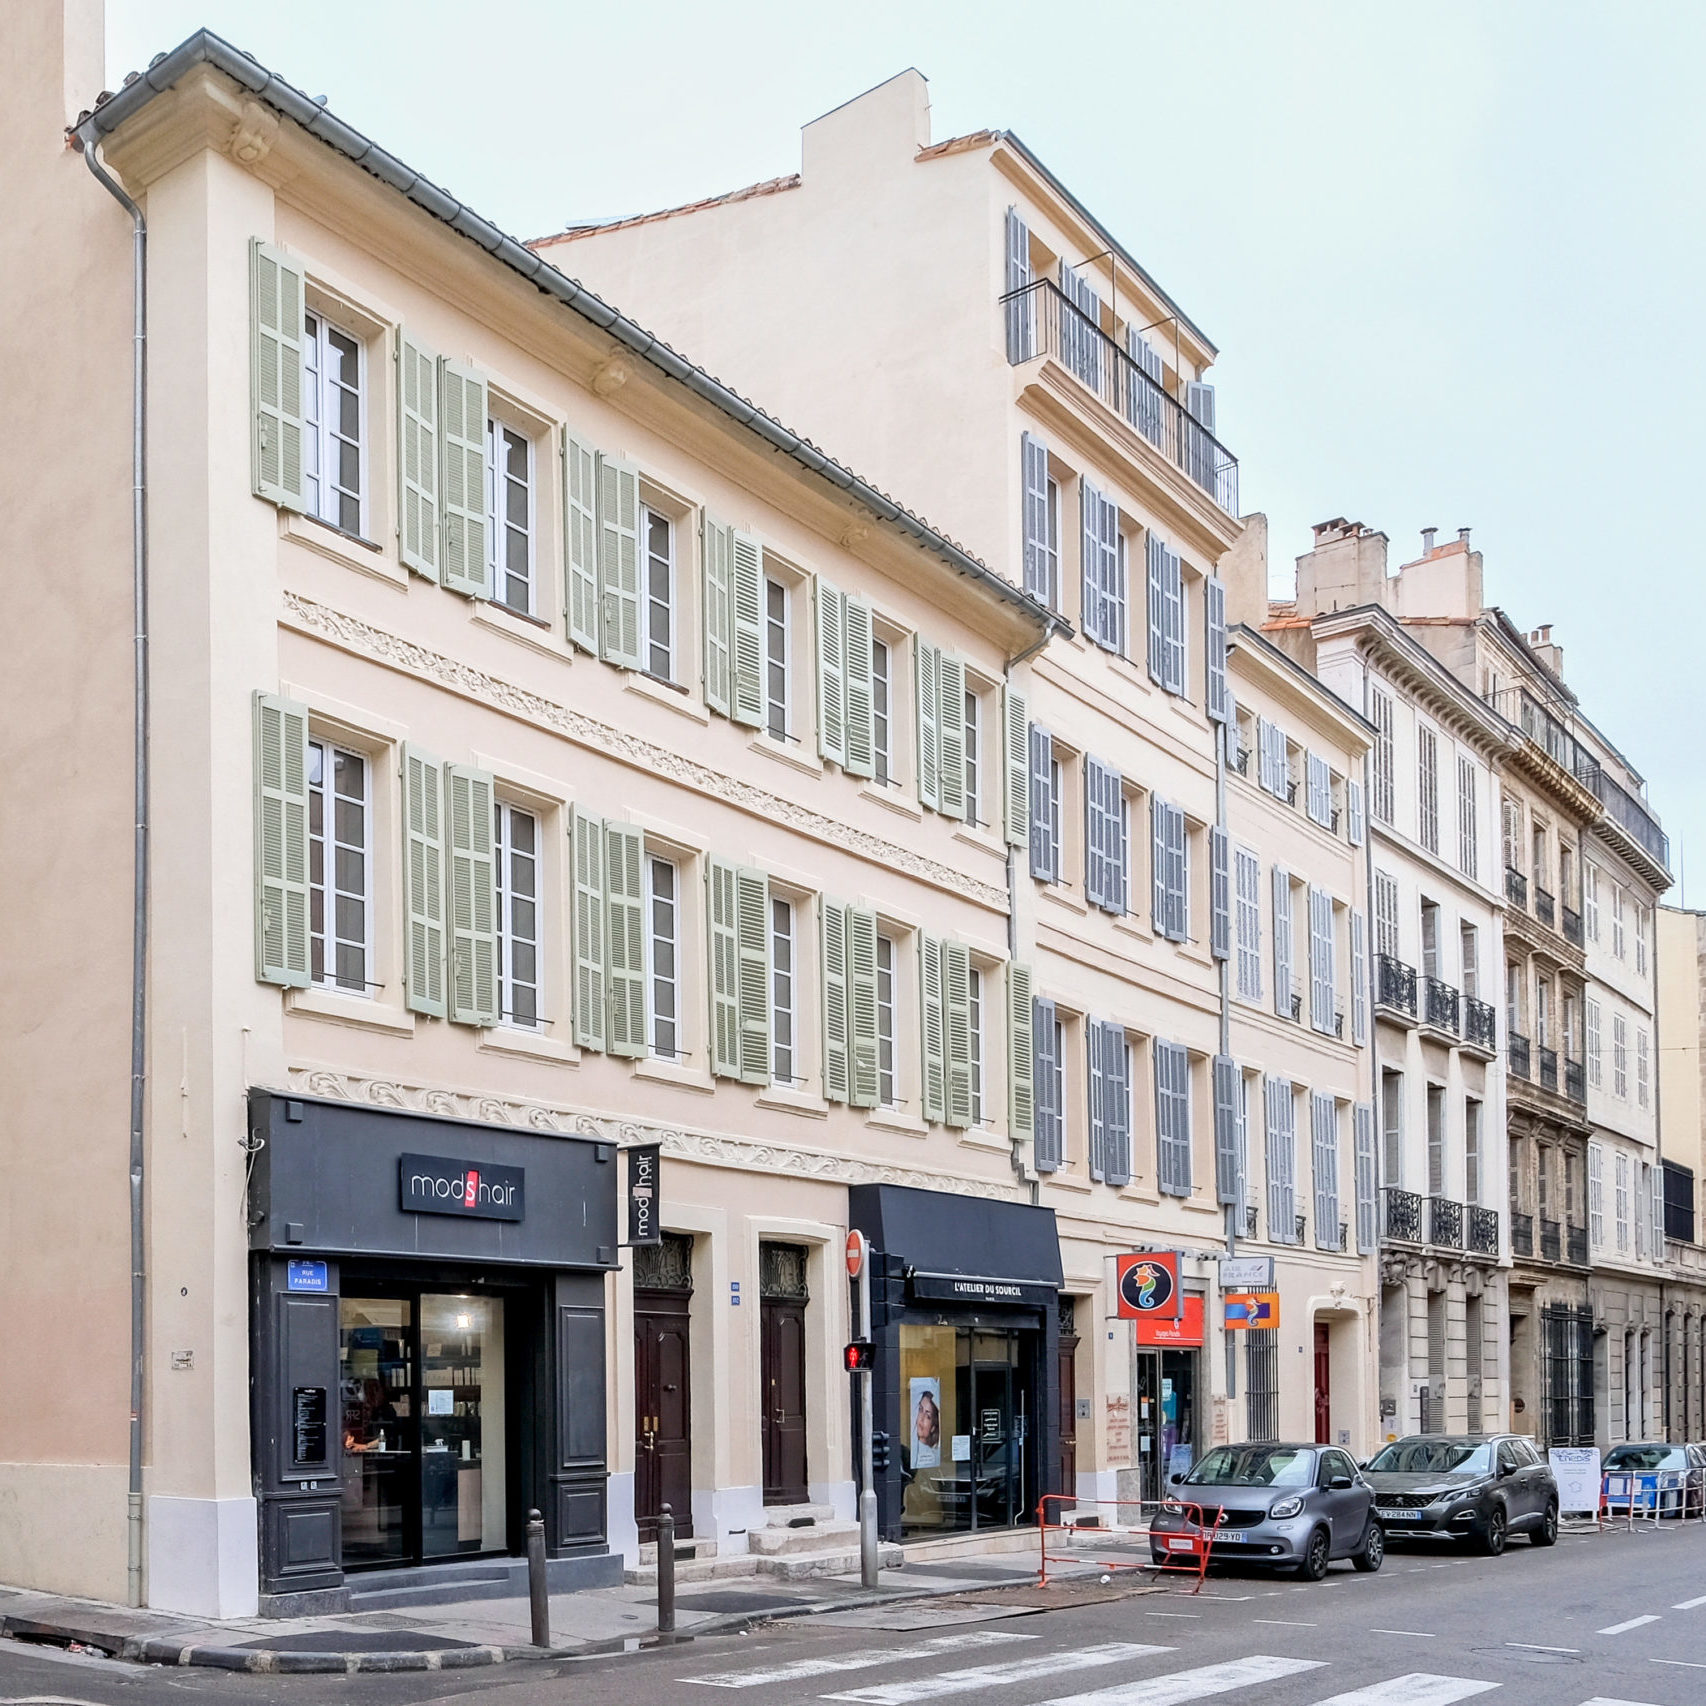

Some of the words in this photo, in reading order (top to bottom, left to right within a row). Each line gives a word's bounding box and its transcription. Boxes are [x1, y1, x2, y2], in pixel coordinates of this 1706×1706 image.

[294, 1278, 322, 1286] PARADIS
[954, 1282, 984, 1293] L'ATELIER
[985, 1284, 995, 1294] DU
[995, 1285, 1022, 1296] SOURCIL
